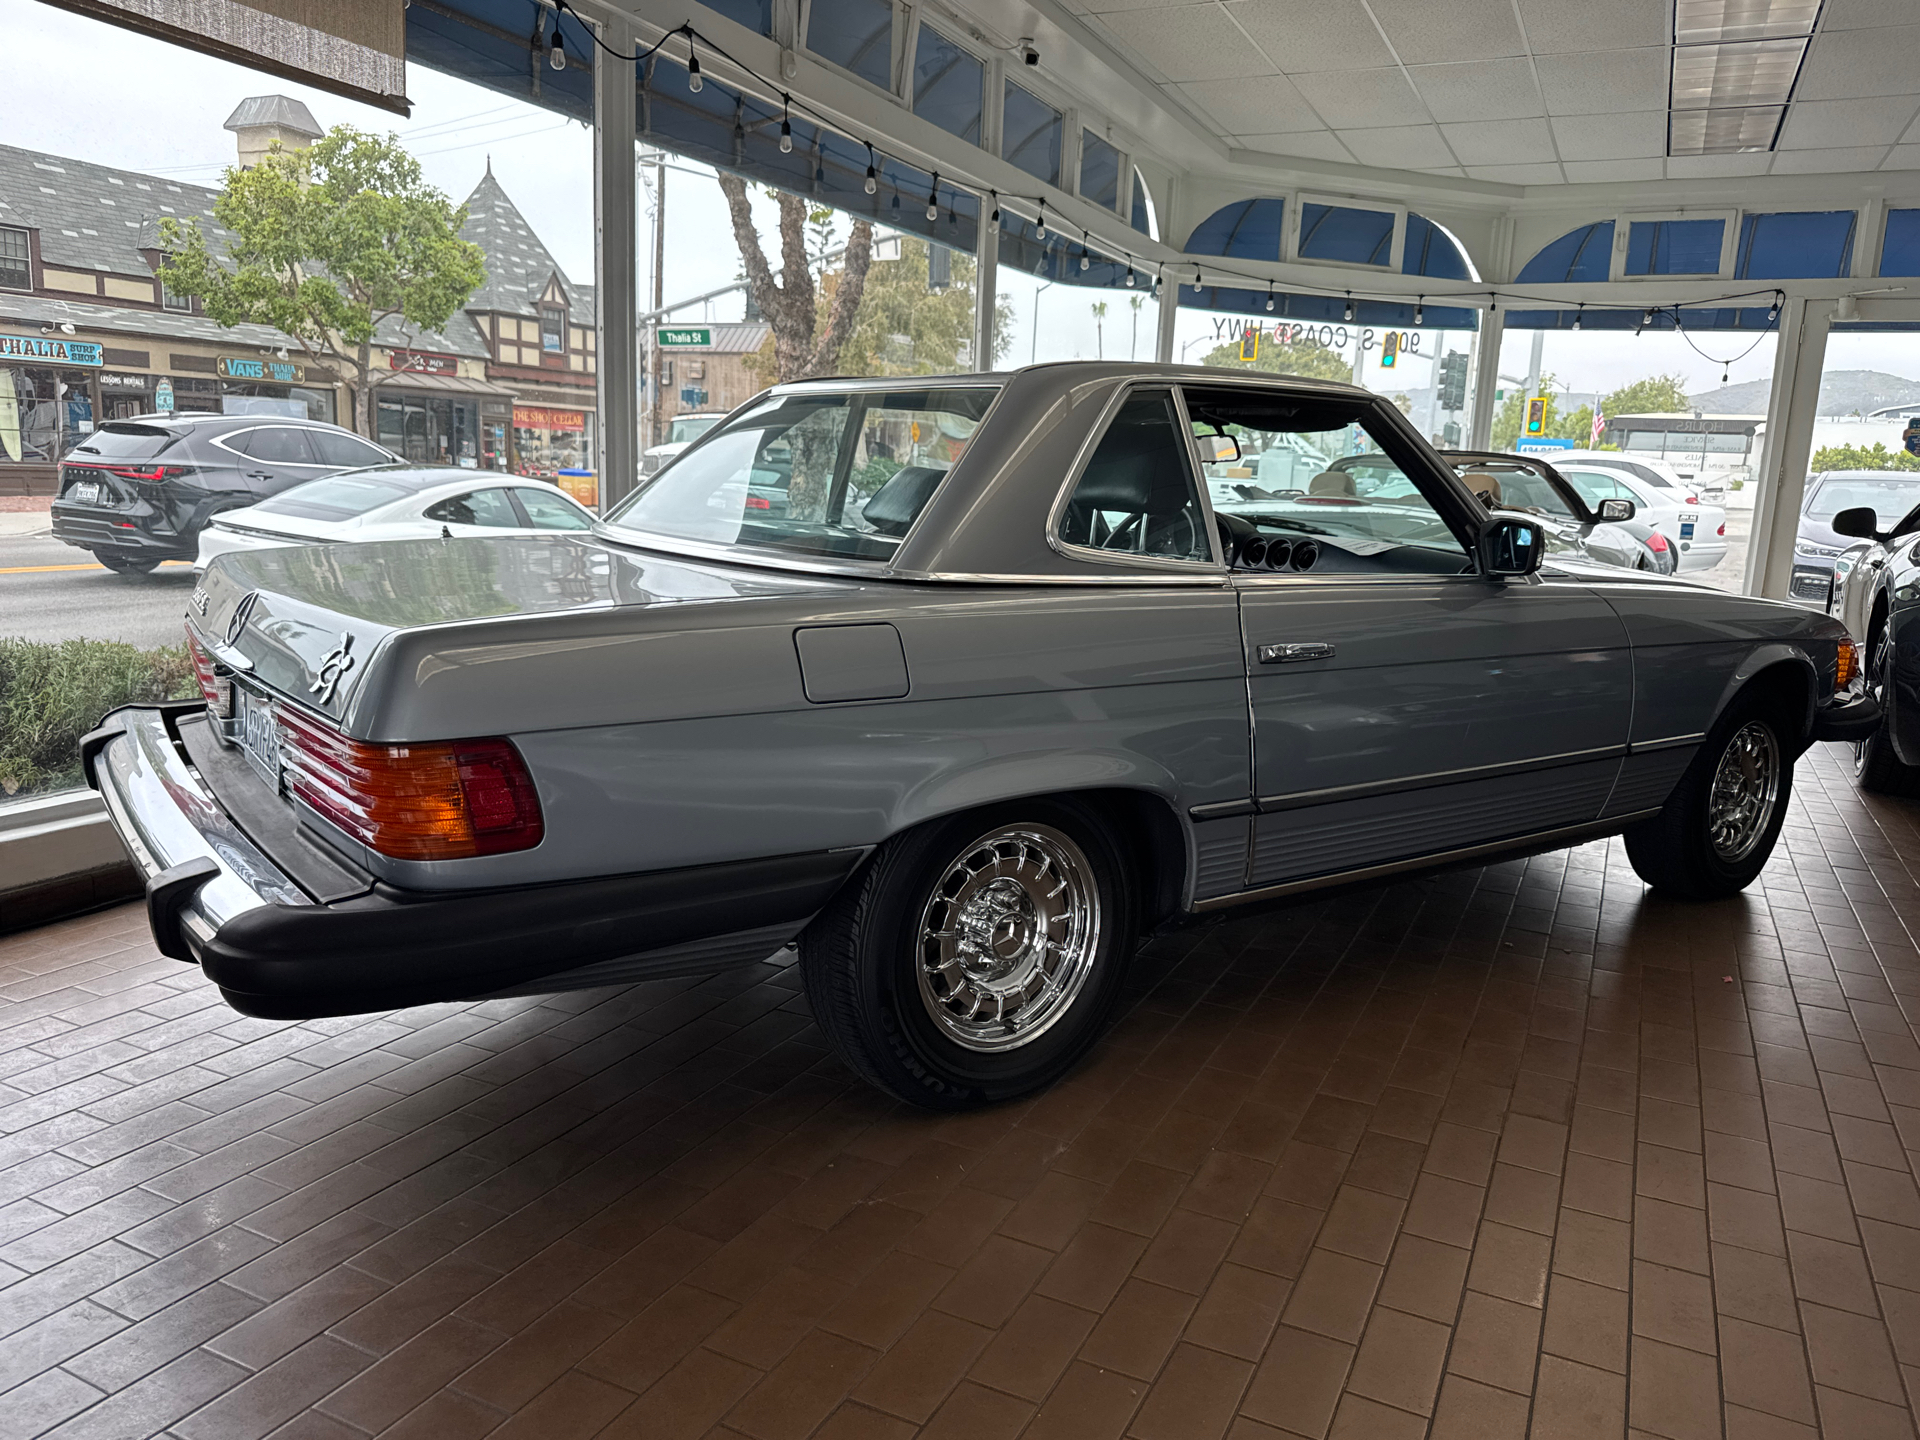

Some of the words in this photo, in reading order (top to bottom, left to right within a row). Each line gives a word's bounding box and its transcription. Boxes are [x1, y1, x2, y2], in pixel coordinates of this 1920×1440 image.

[666, 332, 691, 343] Thalia
[692, 332, 702, 343] St
[0, 338, 69, 359] THALIA
[71, 353, 96, 362] SHOP
[226, 359, 263, 378] VANS
[268, 362, 296, 374] THALIA
[513, 411, 529, 421] THE
[530, 411, 552, 423] SHOE
[553, 414, 583, 425] CELLAR
[879, 1006, 972, 1100] KUMHO
